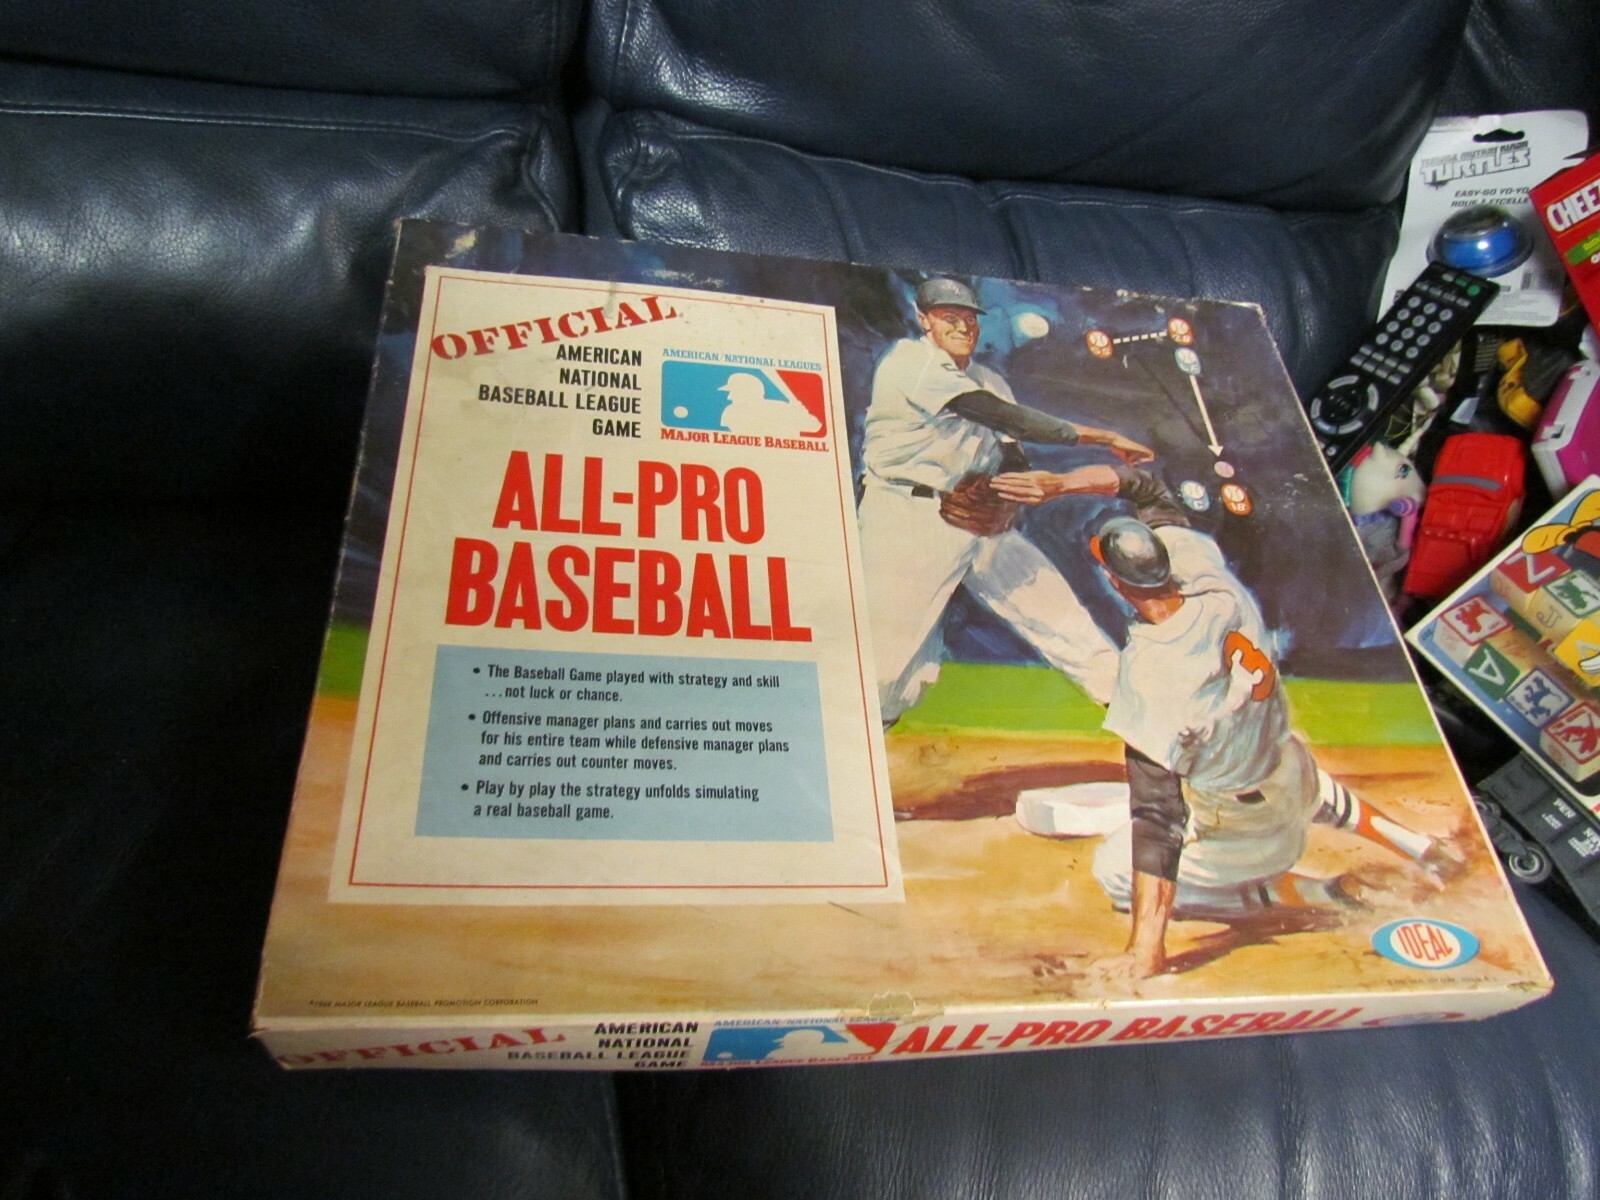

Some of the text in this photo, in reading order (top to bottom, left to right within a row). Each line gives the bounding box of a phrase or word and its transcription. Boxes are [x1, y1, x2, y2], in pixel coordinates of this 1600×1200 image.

[1419, 147, 1531, 187] TURTLES
[431, 295, 678, 361] OFFICIAL
[556, 343, 642, 366] AMERICAN
[778, 358, 823, 372] LEAGUES
[559, 367, 642, 391] NATIONAL
[478, 384, 642, 414] BASEBALL LEAGUE
[592, 418, 641, 438] GAME
[660, 428, 830, 452] MAJOR LEAGUE BASEBALL
[492, 450, 765, 545] ALL-PRO
[444, 536, 813, 643] BASEBALL
[488, 663, 780, 689] The Baseball Game played with strategy and skill
[529, 685, 554, 699] luck
[559, 689, 572, 700] or
[576, 687, 623, 702] chance.
[482, 710, 773, 733] Offensive manager plans and carries out moves
[481, 730, 789, 754] for his entire team while defensive manager plans
[478, 752, 677, 771] and carries out counter moves.
[476, 779, 760, 802] Play by play the strategy unfolds simulating
[473, 802, 615, 821] a real baseball game.
[1396, 923, 1454, 962] IDEAL
[593, 1021, 699, 1035] AMERICAN
[889, 1007, 1365, 1057] ALL-PRO BASEBALL
[598, 1037, 697, 1049] NATIONAL
[507, 1050, 691, 1061] BASEBALL LEAGUE
